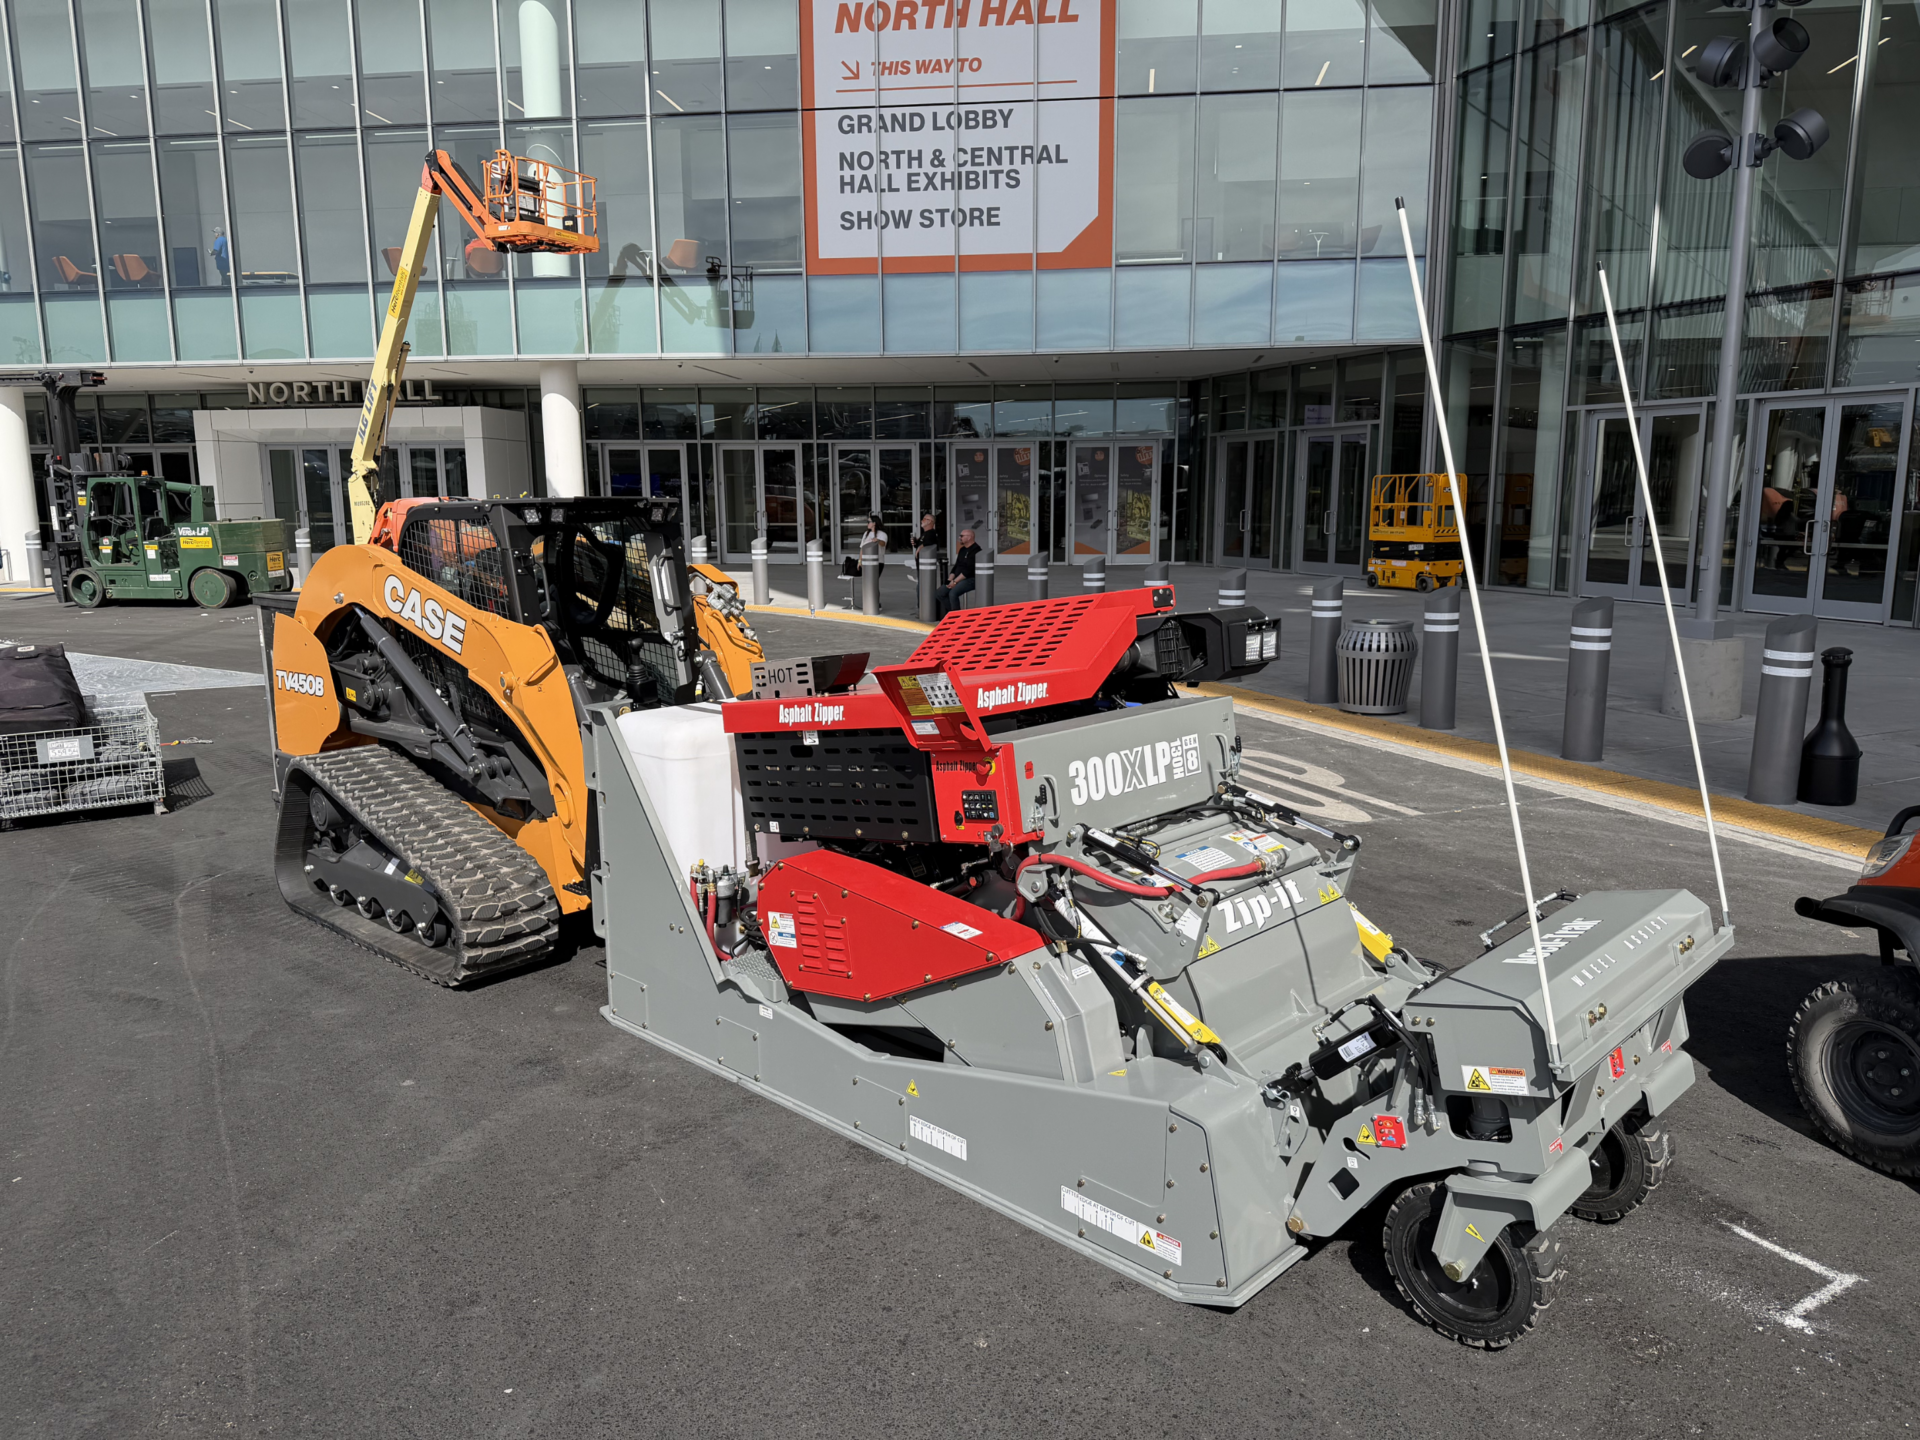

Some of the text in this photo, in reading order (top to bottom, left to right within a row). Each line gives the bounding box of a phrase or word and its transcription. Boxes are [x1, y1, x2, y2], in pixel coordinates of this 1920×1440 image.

[835, 0, 1080, 34] NORTH HALL
[871, 57, 982, 77] THIS WAY TO
[837, 108, 1014, 135] GRAND LOBBY
[839, 144, 1069, 171] NORTH & CENTRAL
[839, 168, 1021, 194] HALL EXHIBITS
[839, 206, 1001, 231] SHOW STORE
[247, 381, 354, 403] NORTH
[364, 379, 378, 414] LIFT
[383, 574, 467, 656] CASE
[275, 669, 324, 697] TV450B
[767, 667, 793, 685] HOT
[977, 682, 1048, 711] Asphalt Zipper
[779, 702, 844, 726] Asphalt Zipper
[1184, 736, 1197, 746] GEN
[936, 760, 957, 774] Asphalt
[1186, 749, 1199, 770] 8
[1068, 741, 1171, 806] 300XLP
[1216, 879, 1304, 934] Zip-it
[1571, 915, 1669, 987] WHEEL ASSIST
[1100, 1204, 1116, 1216] DEPTH
[1124, 1217, 1135, 1227] CUT
